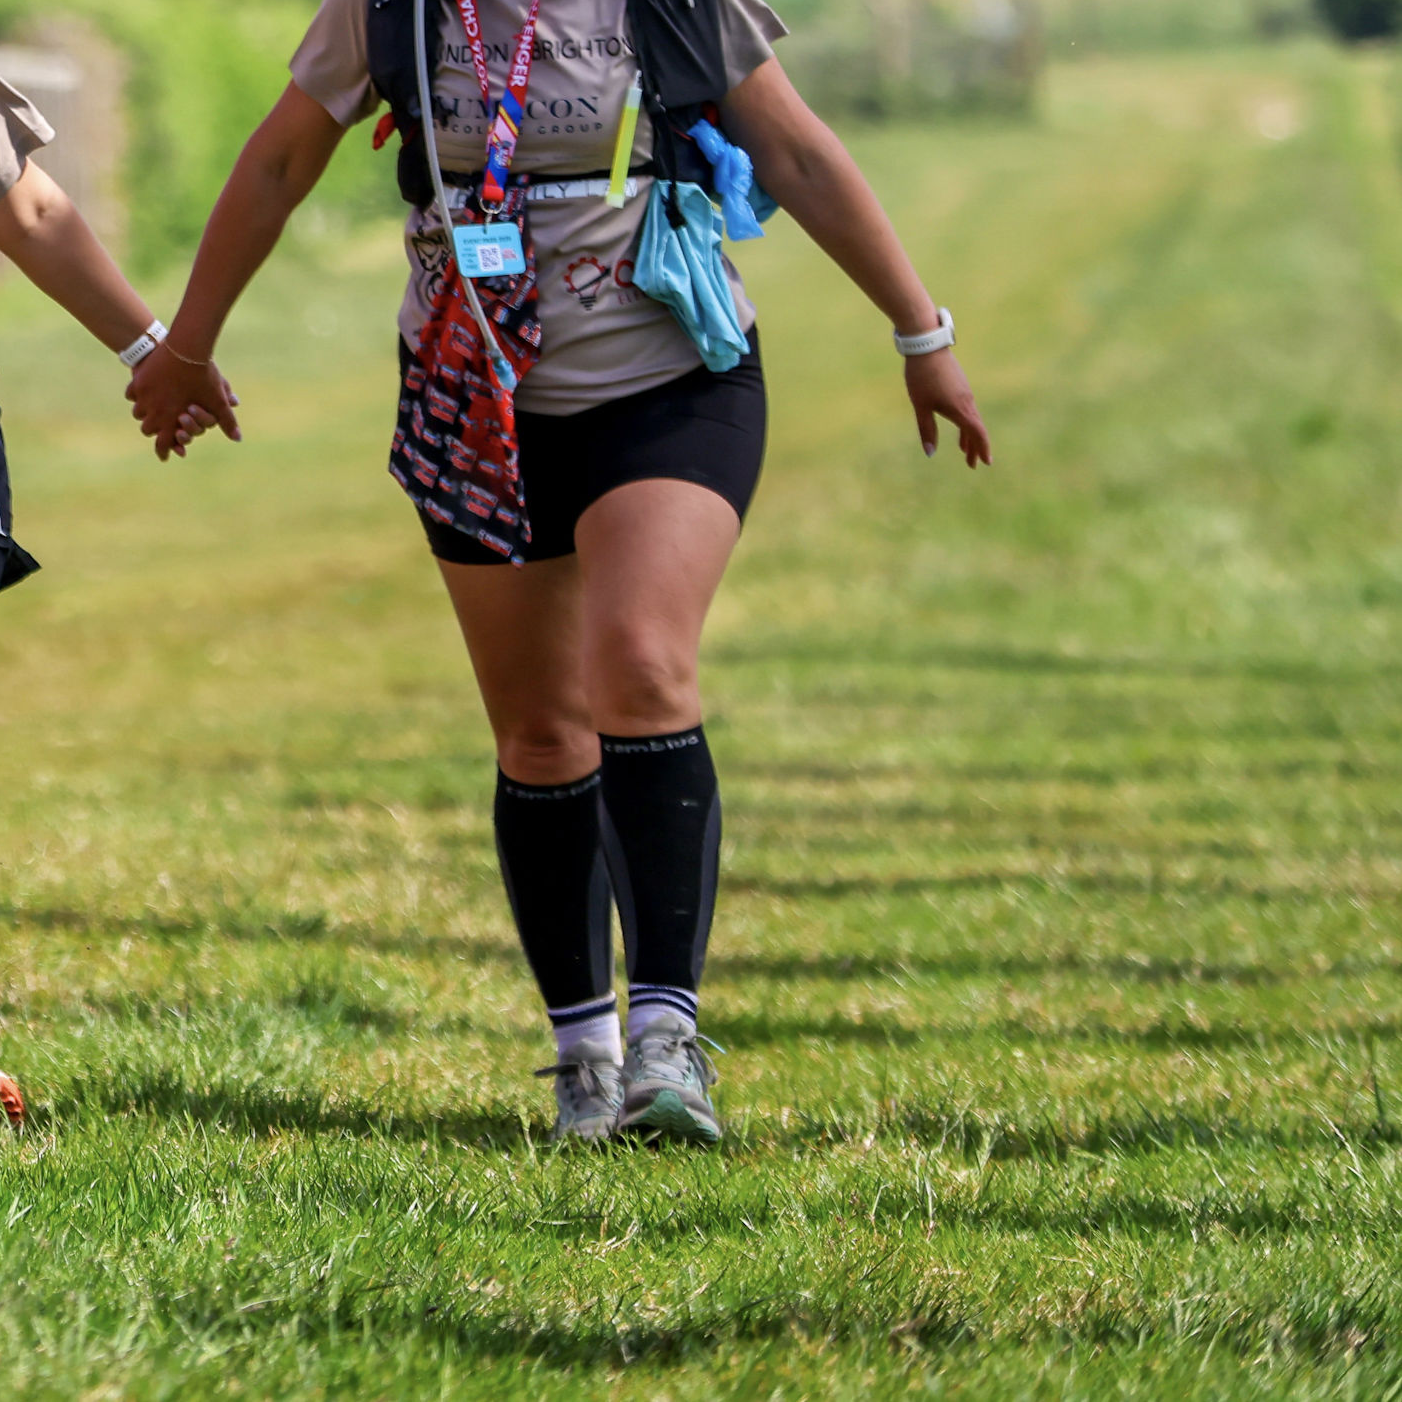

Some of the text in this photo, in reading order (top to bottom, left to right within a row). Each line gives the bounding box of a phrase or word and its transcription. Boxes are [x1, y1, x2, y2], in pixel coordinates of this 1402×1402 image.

[446, 36, 636, 65] NDON BRIGHTON
[537, 122, 603, 136] GROUP
